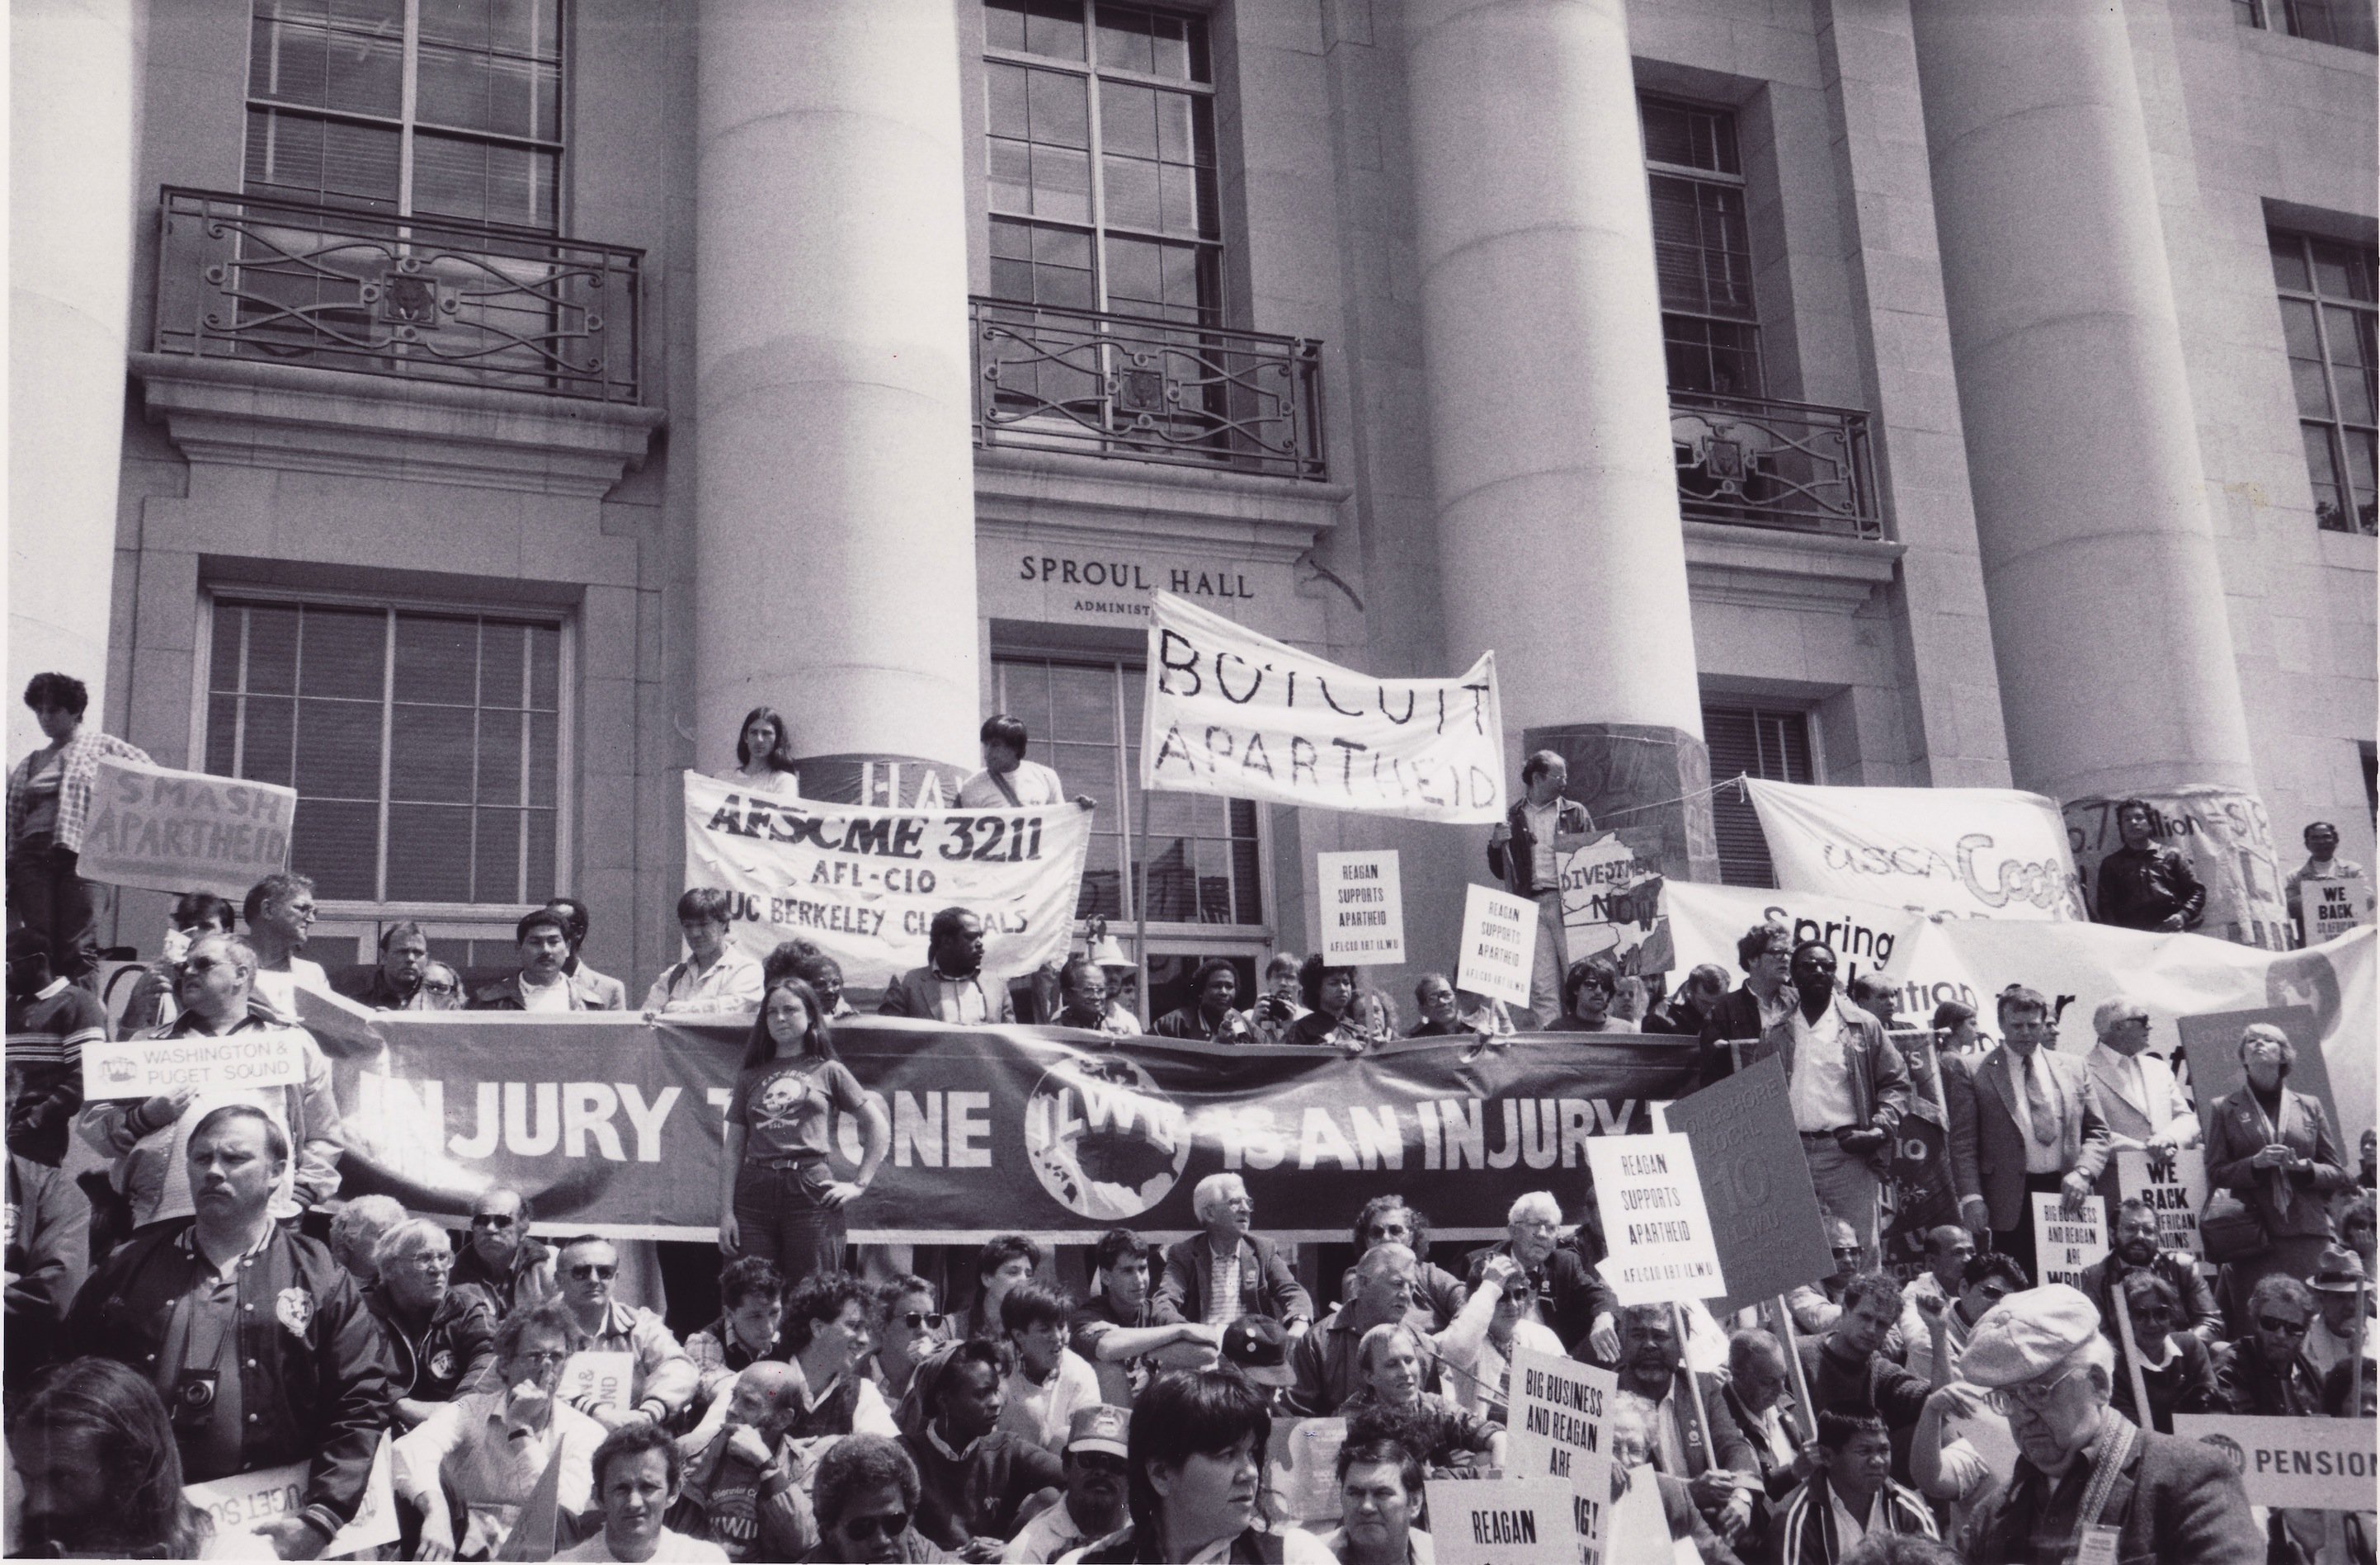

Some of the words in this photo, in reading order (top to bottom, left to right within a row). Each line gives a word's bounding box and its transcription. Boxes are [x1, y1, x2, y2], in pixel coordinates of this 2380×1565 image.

[1020, 556, 1151, 590] SPROUL
[1171, 569, 1255, 598] HALL
[1074, 601, 1151, 615] ADMINIST
[1155, 722, 1497, 808] APARTHEID
[115, 772, 281, 823] SMASH
[86, 804, 287, 865] APARTHEID
[707, 794, 929, 860] AFSCME
[939, 816, 1043, 862] 3211
[811, 860, 936, 893] AFL-CIO
[1343, 864, 1378, 880] REAGAN
[1338, 887, 1384, 904] SUPPORTS
[2323, 887, 2346, 902] WE
[726, 890, 761, 922] UC
[771, 898, 887, 936] BERKELEY
[903, 909, 1029, 937] CLALS
[1339, 910, 1387, 927] APARTHEID
[1488, 901, 1520, 922] REAGAN
[1592, 893, 1654, 933] NOW
[2318, 904, 2353, 920] BACK
[1481, 922, 1520, 945] SUPPORTS
[1477, 943, 1520, 968] APARTHEID
[143, 1041, 271, 1064] WASHINGTON
[276, 1040, 289, 1055] &
[148, 1068, 212, 1086] PUGET
[224, 1060, 290, 1081] SOUND
[360, 1070, 683, 1163] INJURY
[1298, 1105, 1403, 1171] AN
[1416, 1097, 1637, 1171] INJURY
[1622, 1153, 1668, 1176] REAGAN
[2147, 1162, 2178, 1183] WE
[1621, 1187, 1680, 1211] SUPPORTS
[2142, 1188, 2189, 1209] BACK
[2044, 1205, 2057, 1222] BIG
[2158, 1214, 2196, 1230] FRICAN
[1628, 1221, 1691, 1246] APARTHEID
[2048, 1227, 2063, 1243] AND
[2065, 1227, 2096, 1245] REAGAN
[2157, 1233, 2189, 1248] NIONS
[2067, 1248, 2081, 1265] ARE
[2047, 1271, 2081, 1289] WRO
[1526, 1368, 1544, 1398] BIG
[1547, 1374, 1603, 1418] BUSINESS
[1527, 1404, 1549, 1436] AND
[1553, 1412, 1598, 1454] REAGAN
[1549, 1447, 1572, 1478] ARE
[2255, 1450, 2378, 1478] PENSIO
[247, 1483, 302, 1520] UGET
[1472, 1510, 1537, 1545] REAGAN
